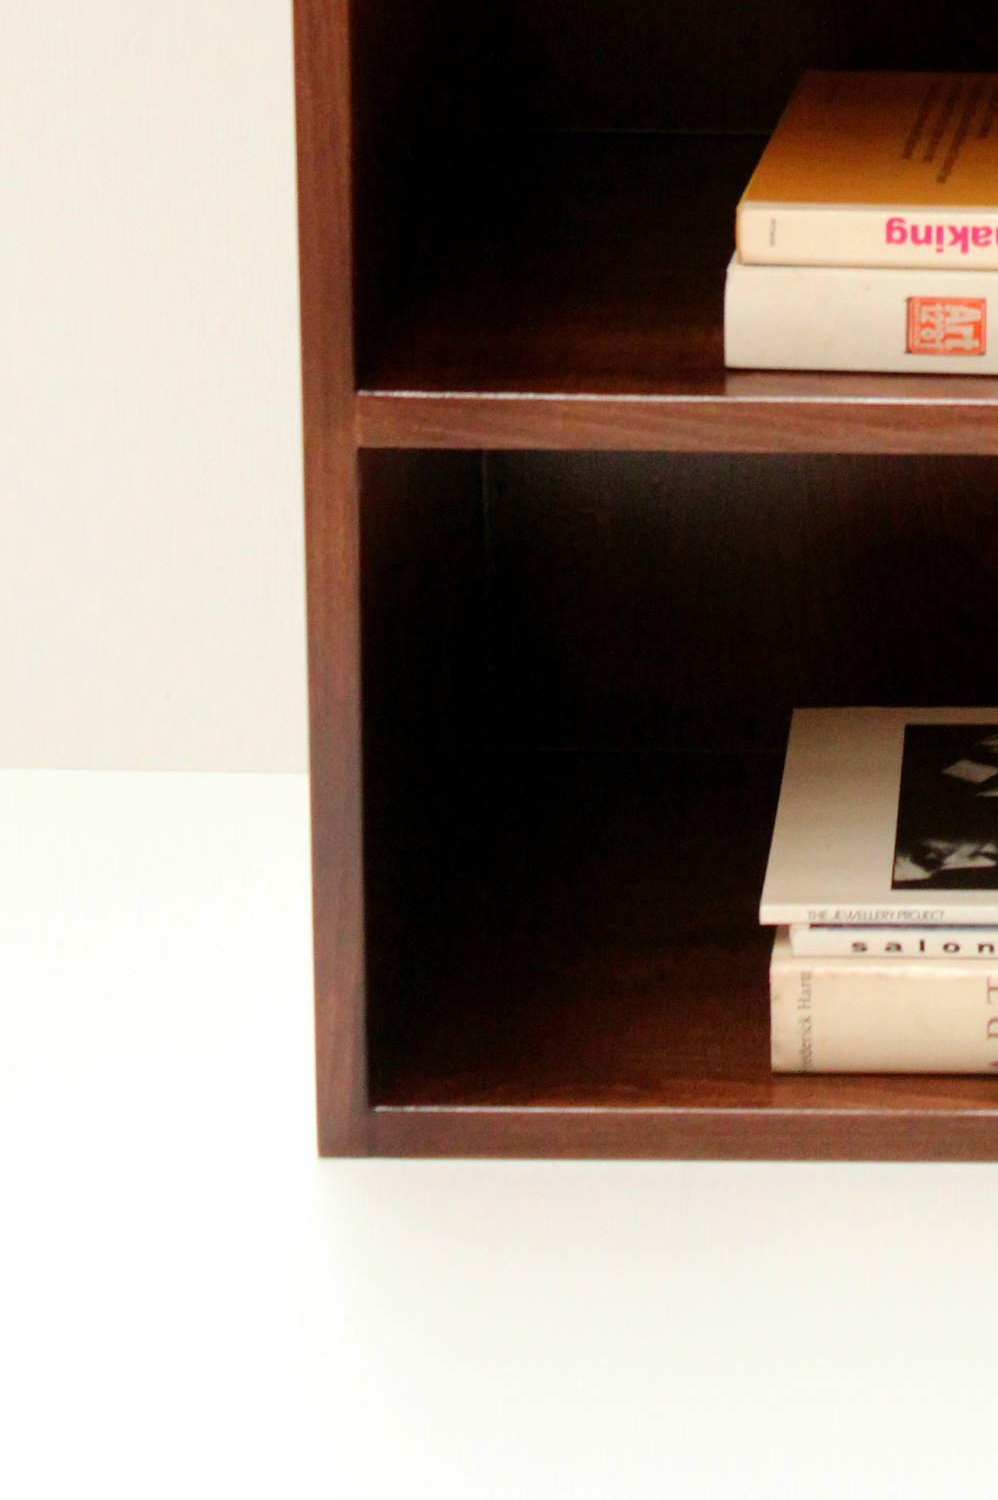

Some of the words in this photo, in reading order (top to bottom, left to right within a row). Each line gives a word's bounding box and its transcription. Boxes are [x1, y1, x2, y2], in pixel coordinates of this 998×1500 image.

[944, 304, 982, 351] Art
[807, 909, 828, 921] THE
[833, 909, 896, 922] JEWELLERY
[896, 909, 945, 922] PROJECT
[852, 938, 995, 953] salon
